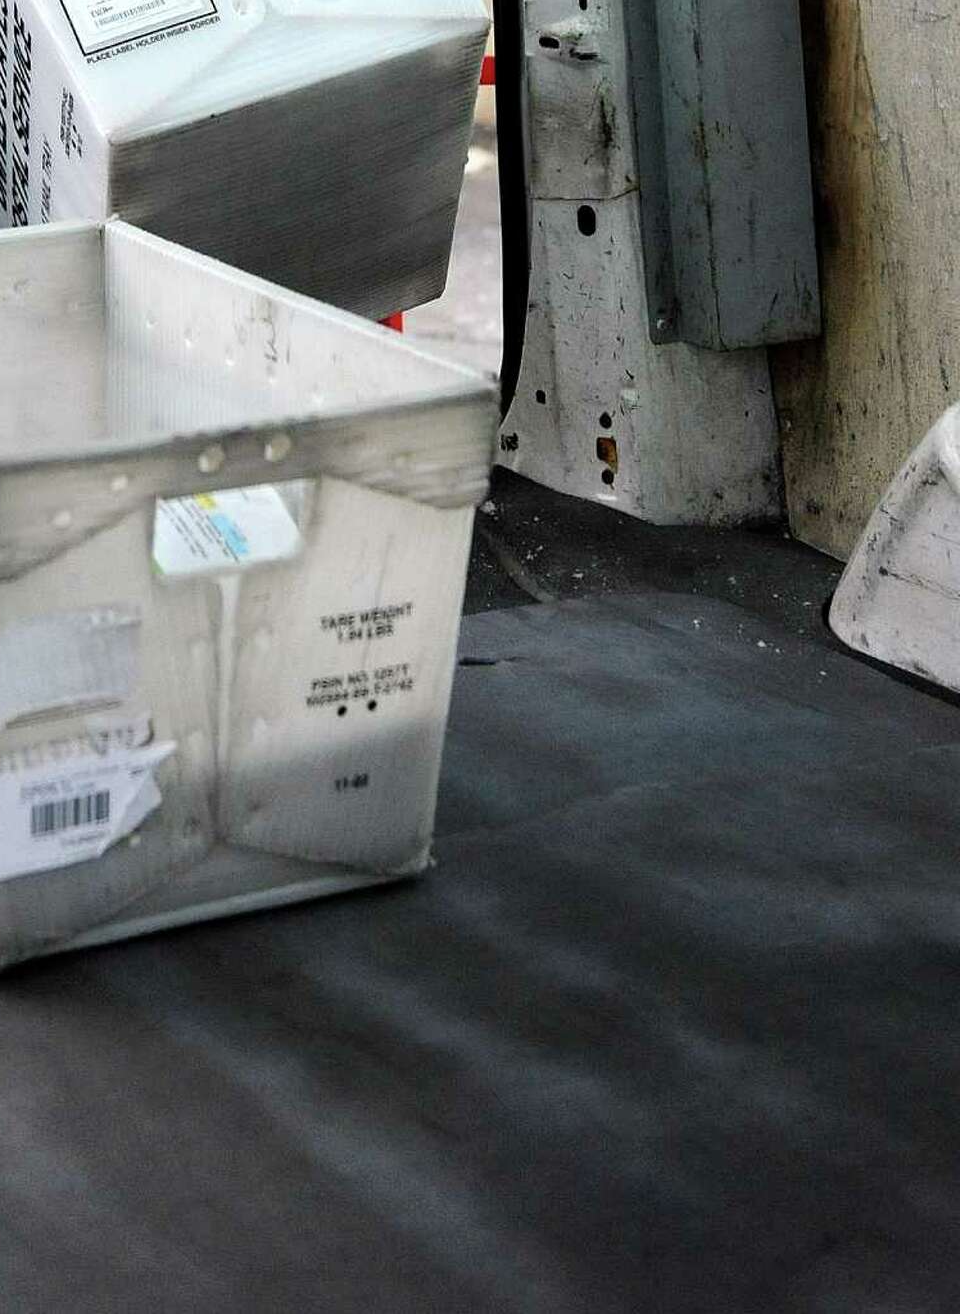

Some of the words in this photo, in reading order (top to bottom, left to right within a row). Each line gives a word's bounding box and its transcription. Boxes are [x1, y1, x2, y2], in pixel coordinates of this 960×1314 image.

[86, 51, 112, 65] PLACE
[112, 43, 136, 57] LABEL
[136, 33, 166, 49] HOLDER
[166, 25, 190, 39] INSIDE
[190, 16, 221, 31] BORDER
[12, 1, 32, 156] SERVICE
[12, 145, 29, 227] OSTAL
[320, 613, 355, 630] TARE
[359, 602, 413, 623] WEIGHT
